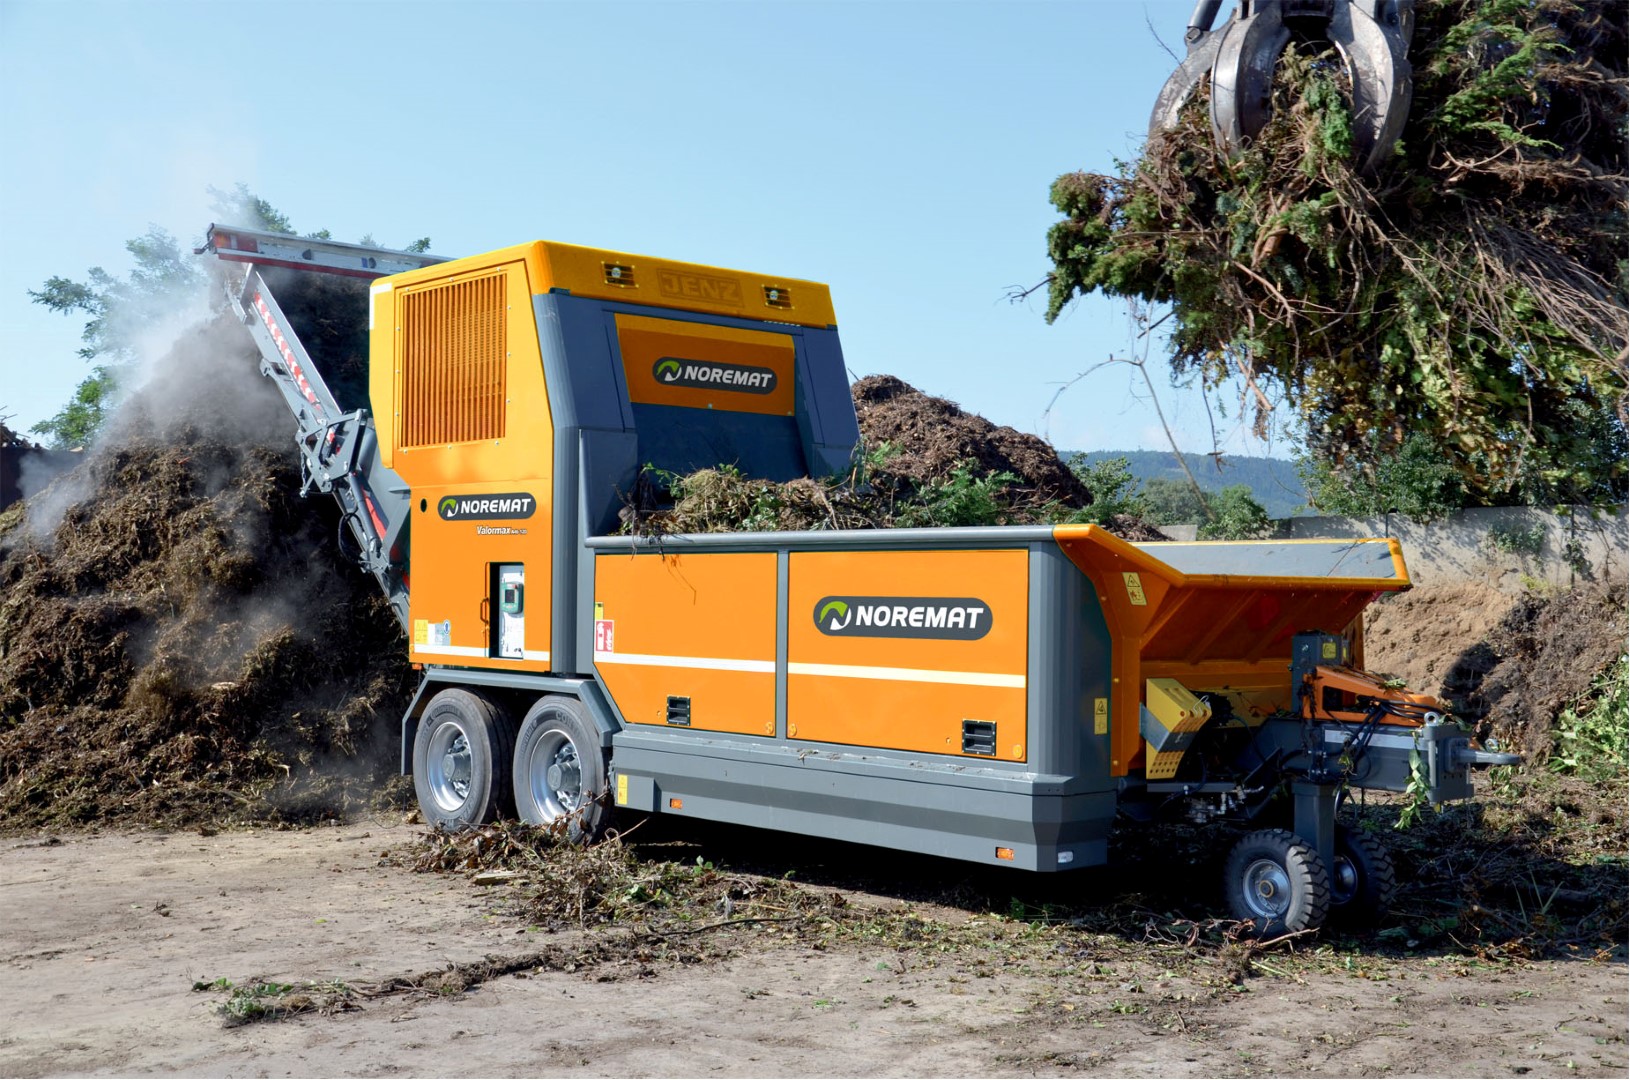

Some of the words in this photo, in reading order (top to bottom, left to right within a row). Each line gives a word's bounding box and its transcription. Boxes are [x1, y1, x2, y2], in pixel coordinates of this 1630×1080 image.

[662, 273, 738, 301] JENZ
[684, 366, 772, 387] NOREMAT
[461, 499, 531, 513] NOREMAT
[477, 525, 511, 535] Valormax
[856, 606, 984, 629] NOREMAT
